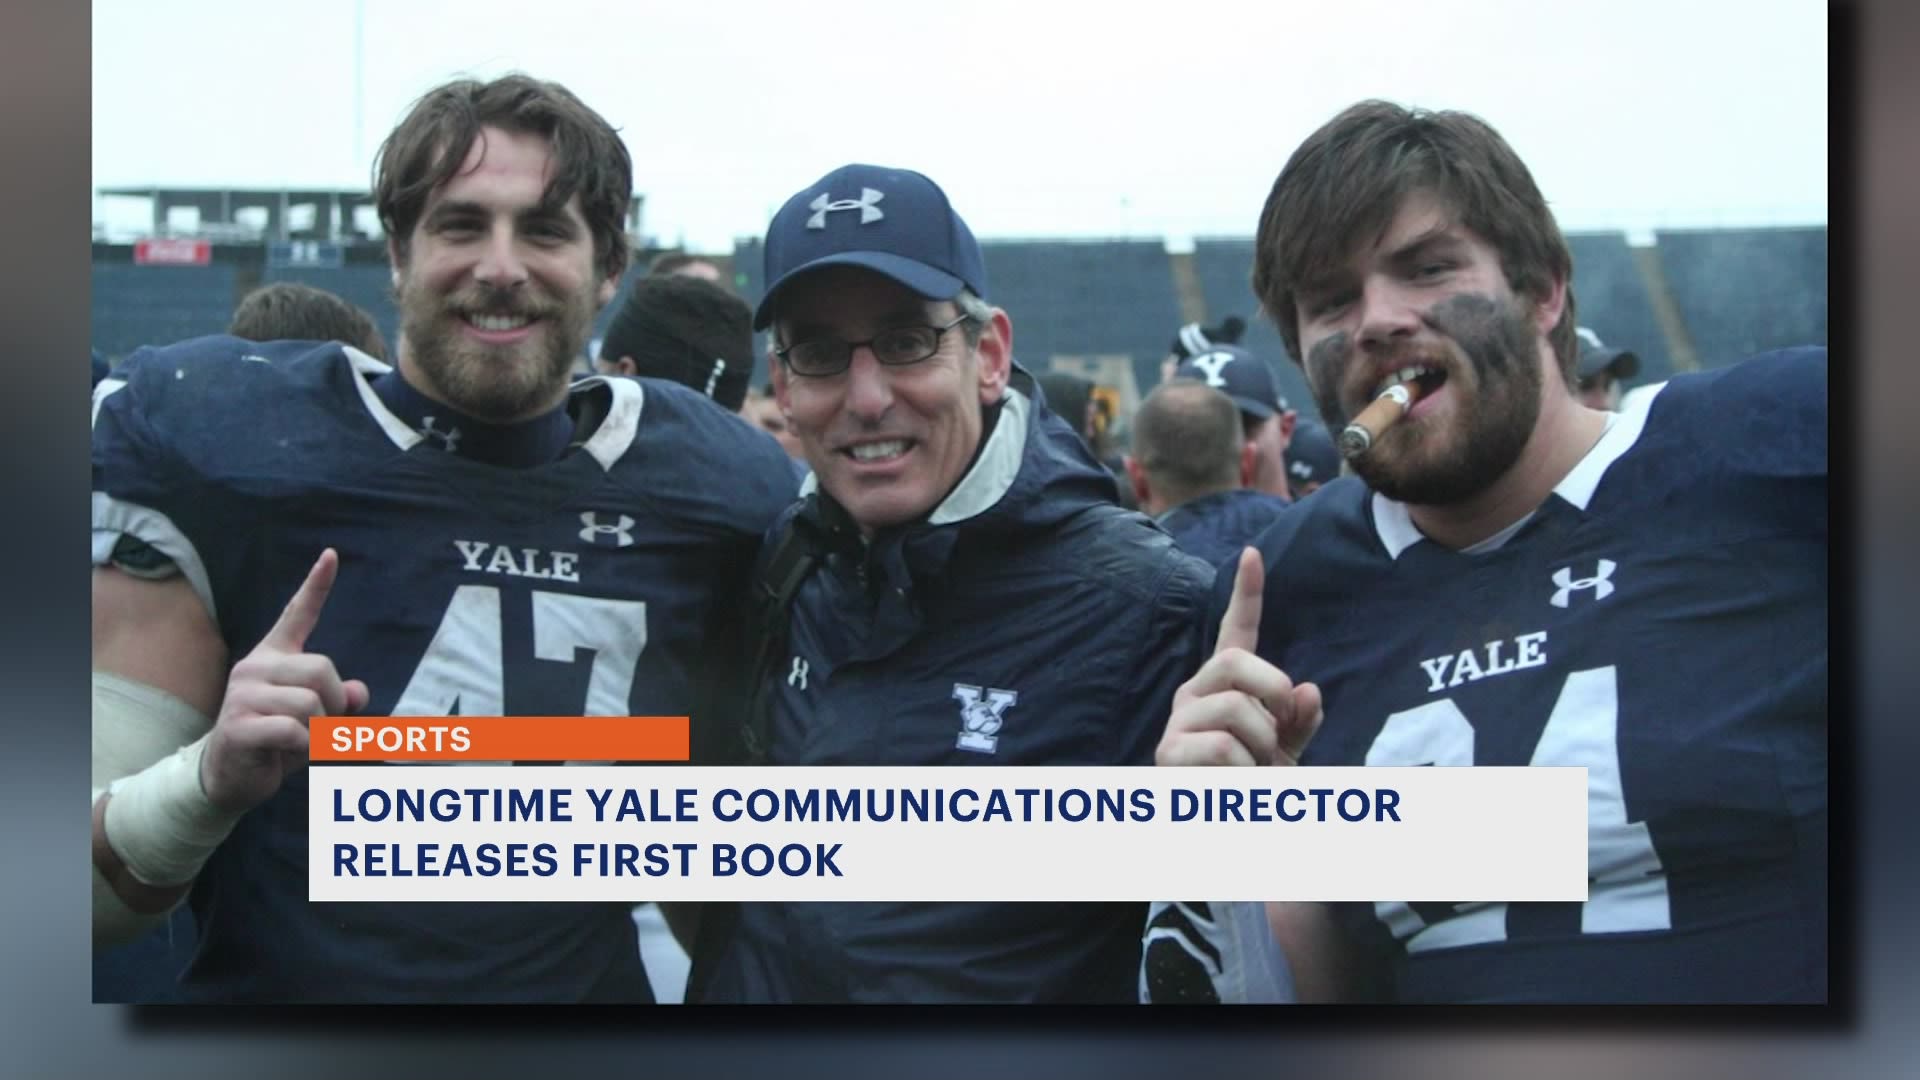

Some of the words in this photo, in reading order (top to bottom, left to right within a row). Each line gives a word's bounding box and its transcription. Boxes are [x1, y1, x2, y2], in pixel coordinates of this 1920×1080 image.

[1193, 352, 1235, 386] Y
[454, 539, 579, 582] YALE
[388, 584, 648, 718] 47
[1420, 630, 1547, 692] YALE
[952, 683, 1018, 754] Y
